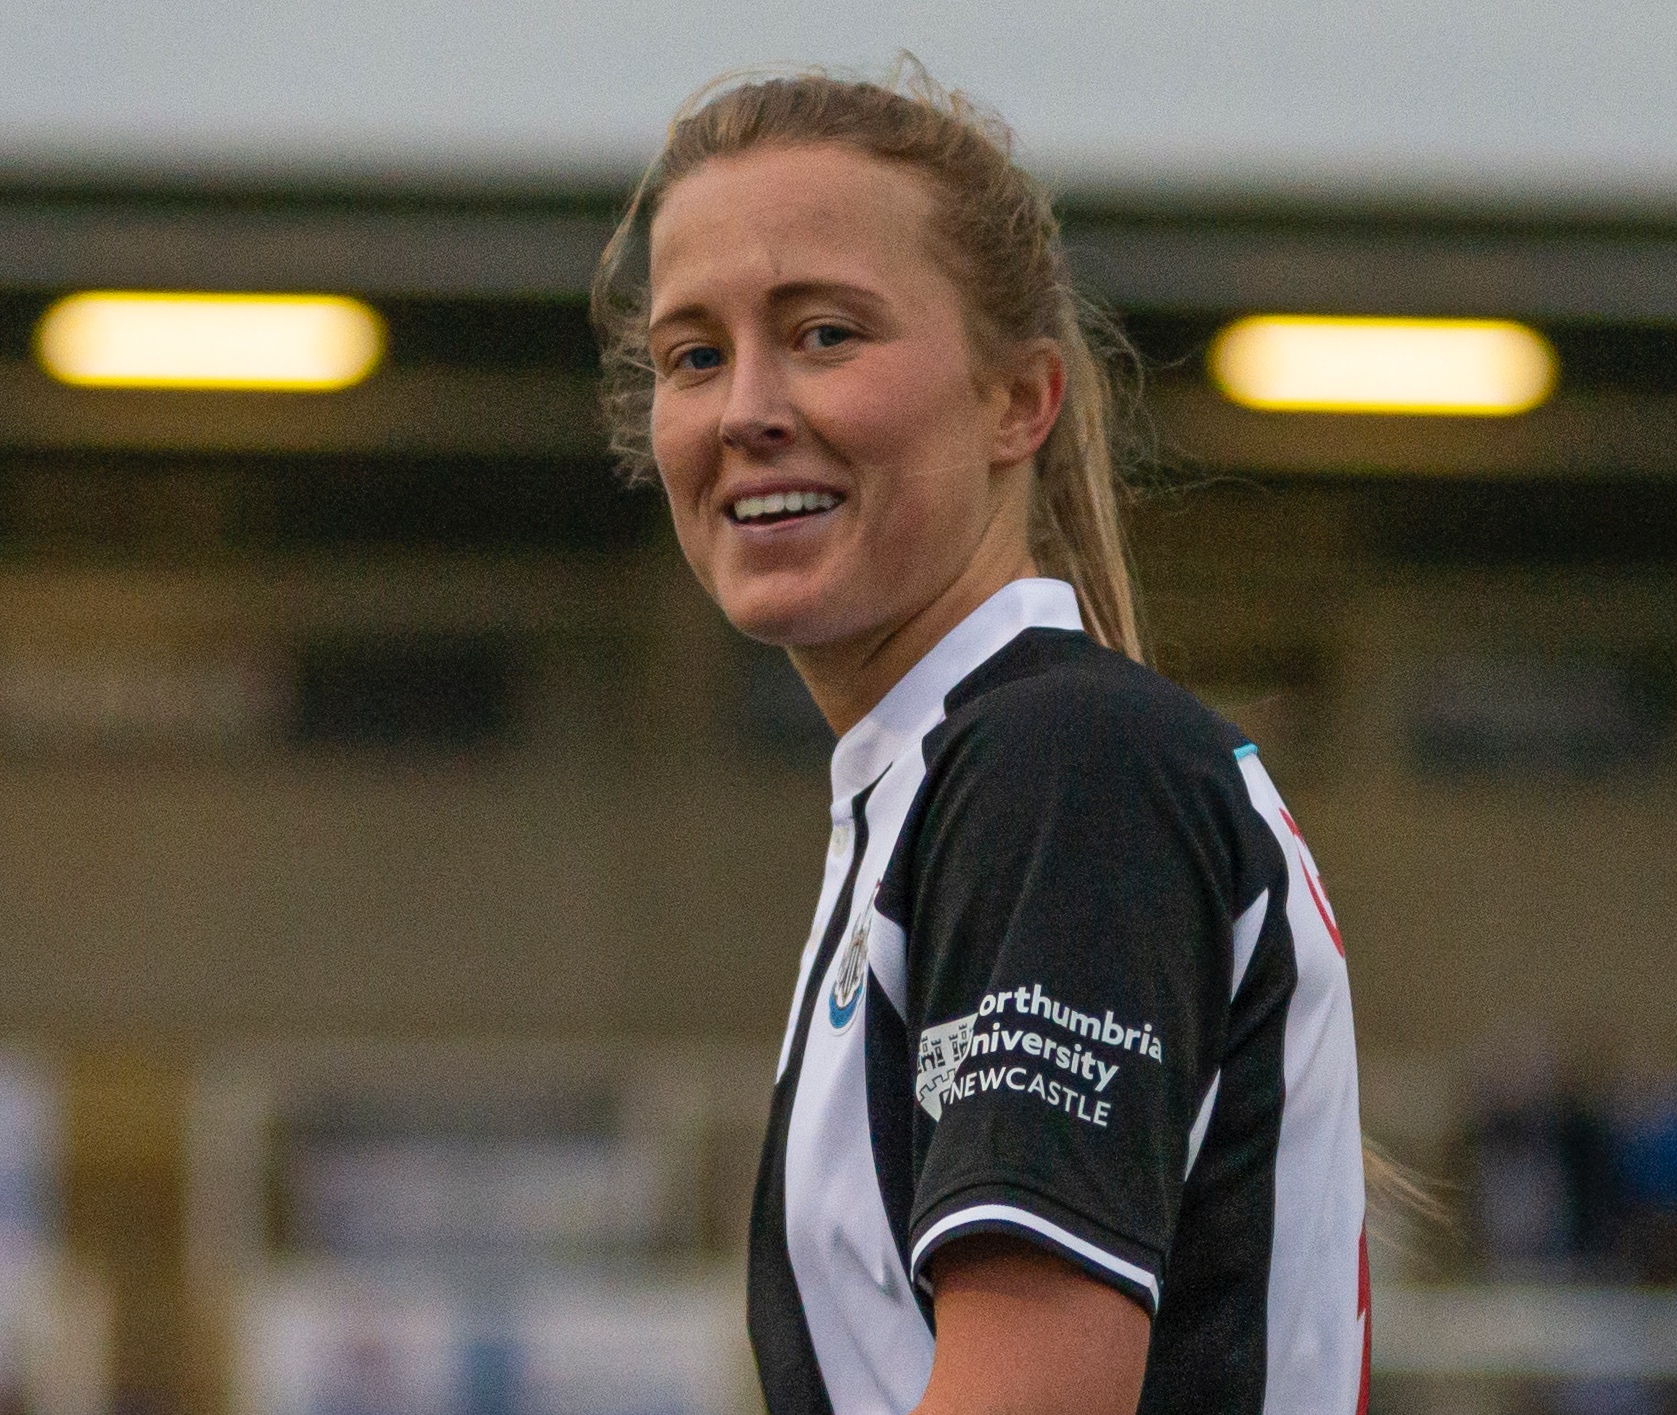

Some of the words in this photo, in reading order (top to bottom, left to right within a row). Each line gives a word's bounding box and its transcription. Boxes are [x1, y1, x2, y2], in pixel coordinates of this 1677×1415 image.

[970, 1022, 1120, 1092] niversity
[979, 983, 1162, 1064] orthumbria
[948, 1066, 1112, 1127] NEWCASTLE
